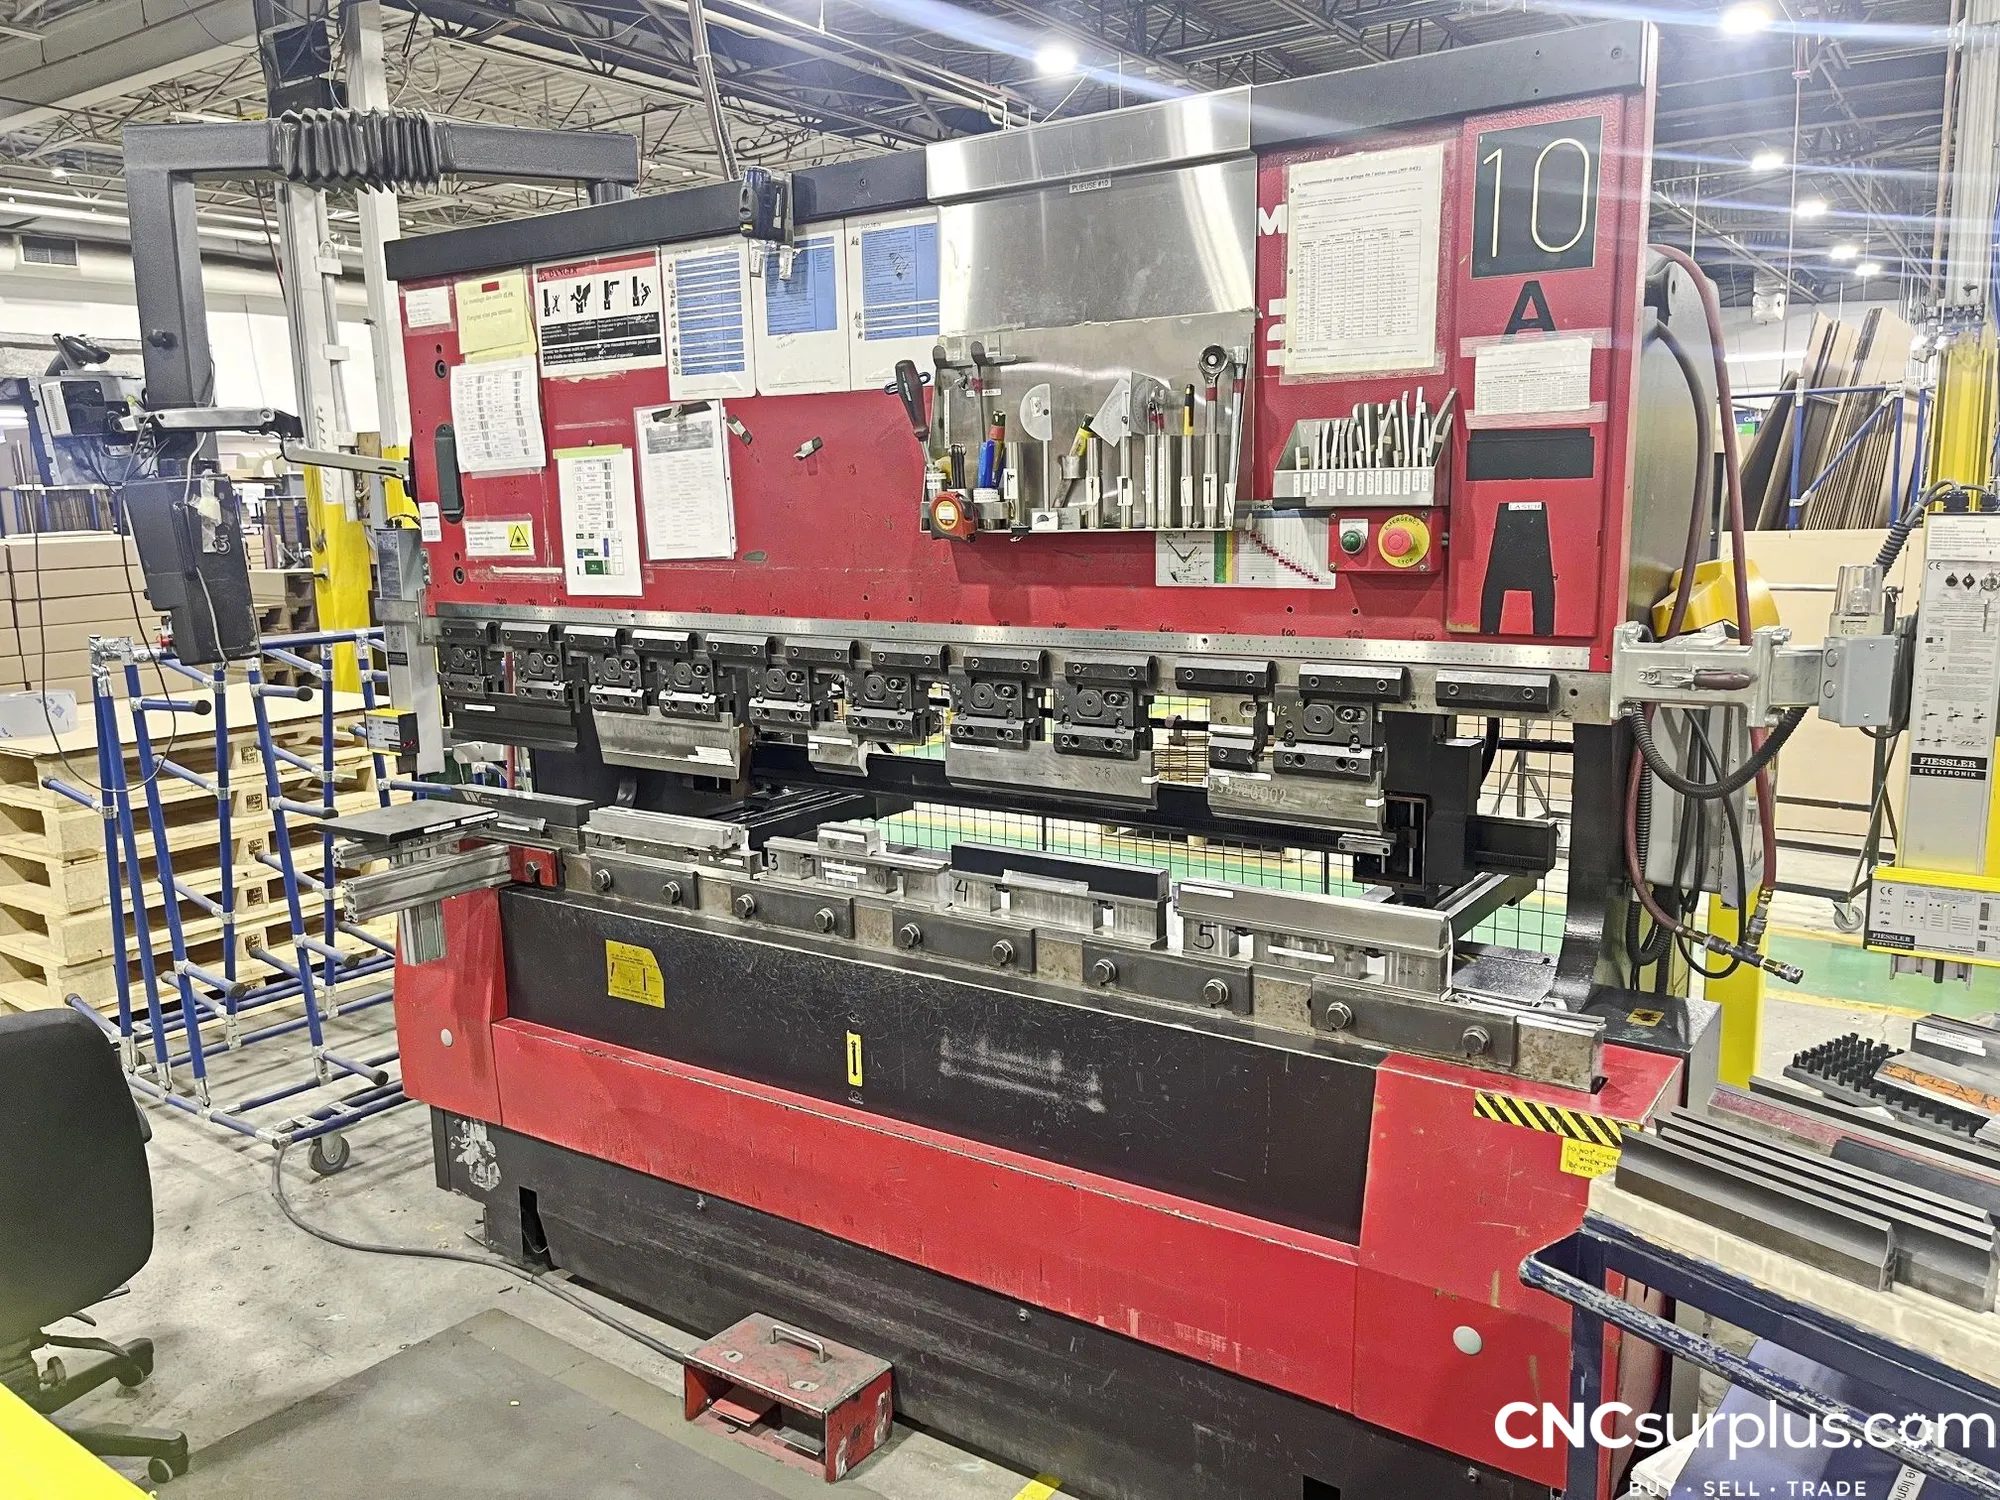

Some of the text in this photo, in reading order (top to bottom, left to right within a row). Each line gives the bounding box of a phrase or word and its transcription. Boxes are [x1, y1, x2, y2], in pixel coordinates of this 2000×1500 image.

[1483, 138, 1589, 257] 10
[1384, 516, 1420, 531] EMERGENCY
[1919, 757, 1977, 769] FIESSLER
[1919, 768, 1977, 778] ELEKTRONIK
[595, 833, 602, 847] 2
[768, 853, 779, 871] 3
[954, 879, 969, 903] 4
[1192, 923, 1217, 950] 5
[1872, 932, 1911, 943] FIESSLER
